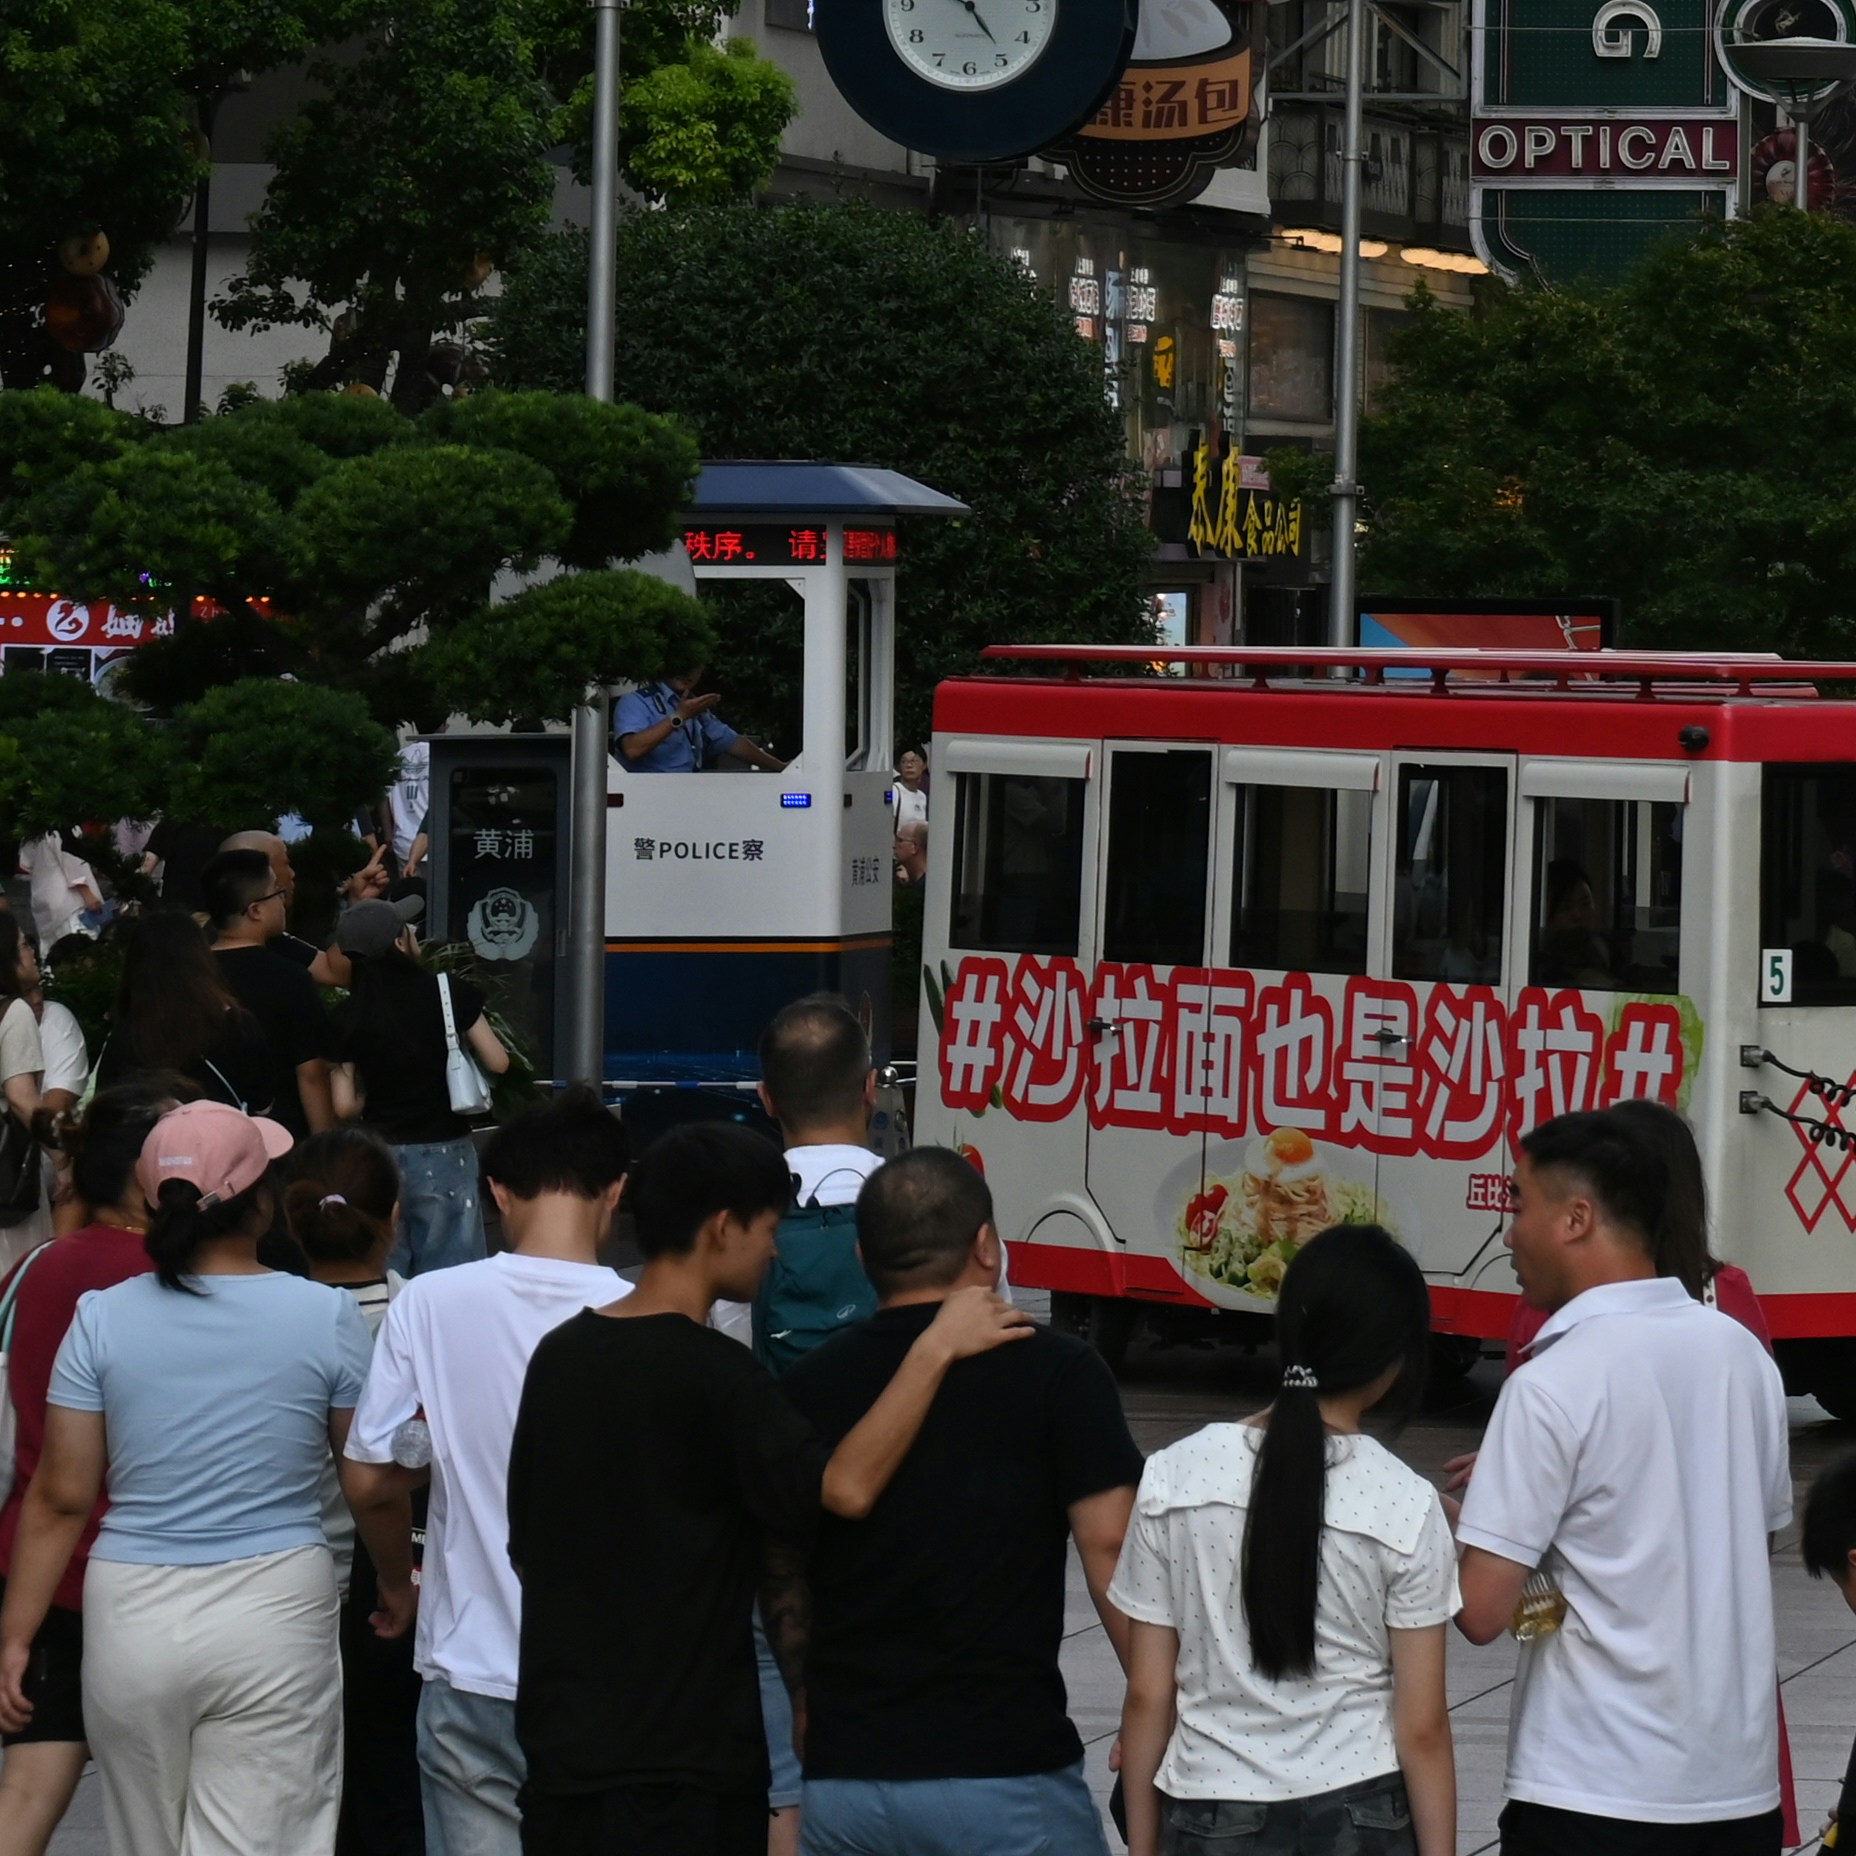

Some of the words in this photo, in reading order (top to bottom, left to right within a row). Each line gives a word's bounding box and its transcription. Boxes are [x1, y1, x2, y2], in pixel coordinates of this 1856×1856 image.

[1477, 124, 1731, 172] OPTICAL
[789, 530, 828, 559] 请
[472, 828, 535, 860] 黄浦
[1769, 955, 1784, 996] 5
